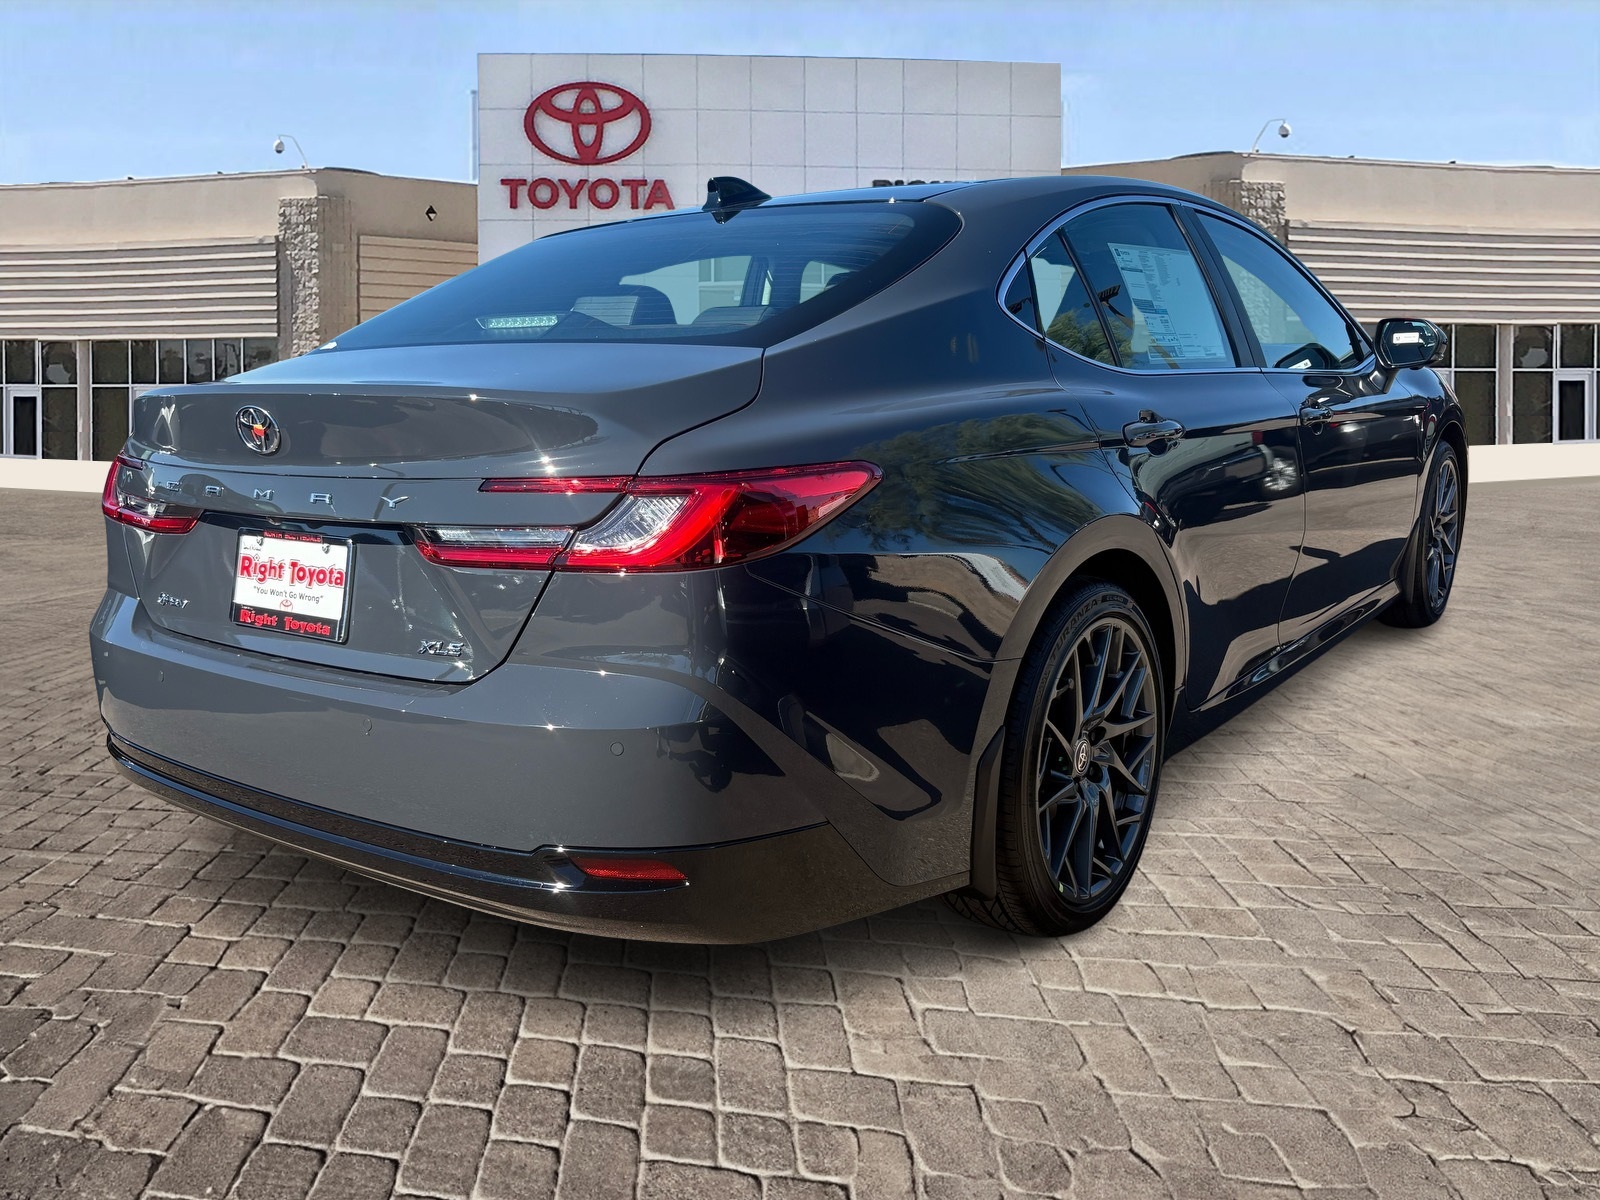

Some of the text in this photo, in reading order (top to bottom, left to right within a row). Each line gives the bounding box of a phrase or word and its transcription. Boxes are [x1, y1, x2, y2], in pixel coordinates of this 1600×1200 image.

[500, 177, 675, 210] TOYOTA
[166, 480, 409, 510] CAMRY
[240, 555, 345, 588] Right Toyota
[269, 588, 288, 598] Won't
[289, 591, 298, 599] Go
[298, 592, 324, 604] Wrong"
[240, 609, 331, 636] Right Toyota
[417, 640, 465, 657] XLE
